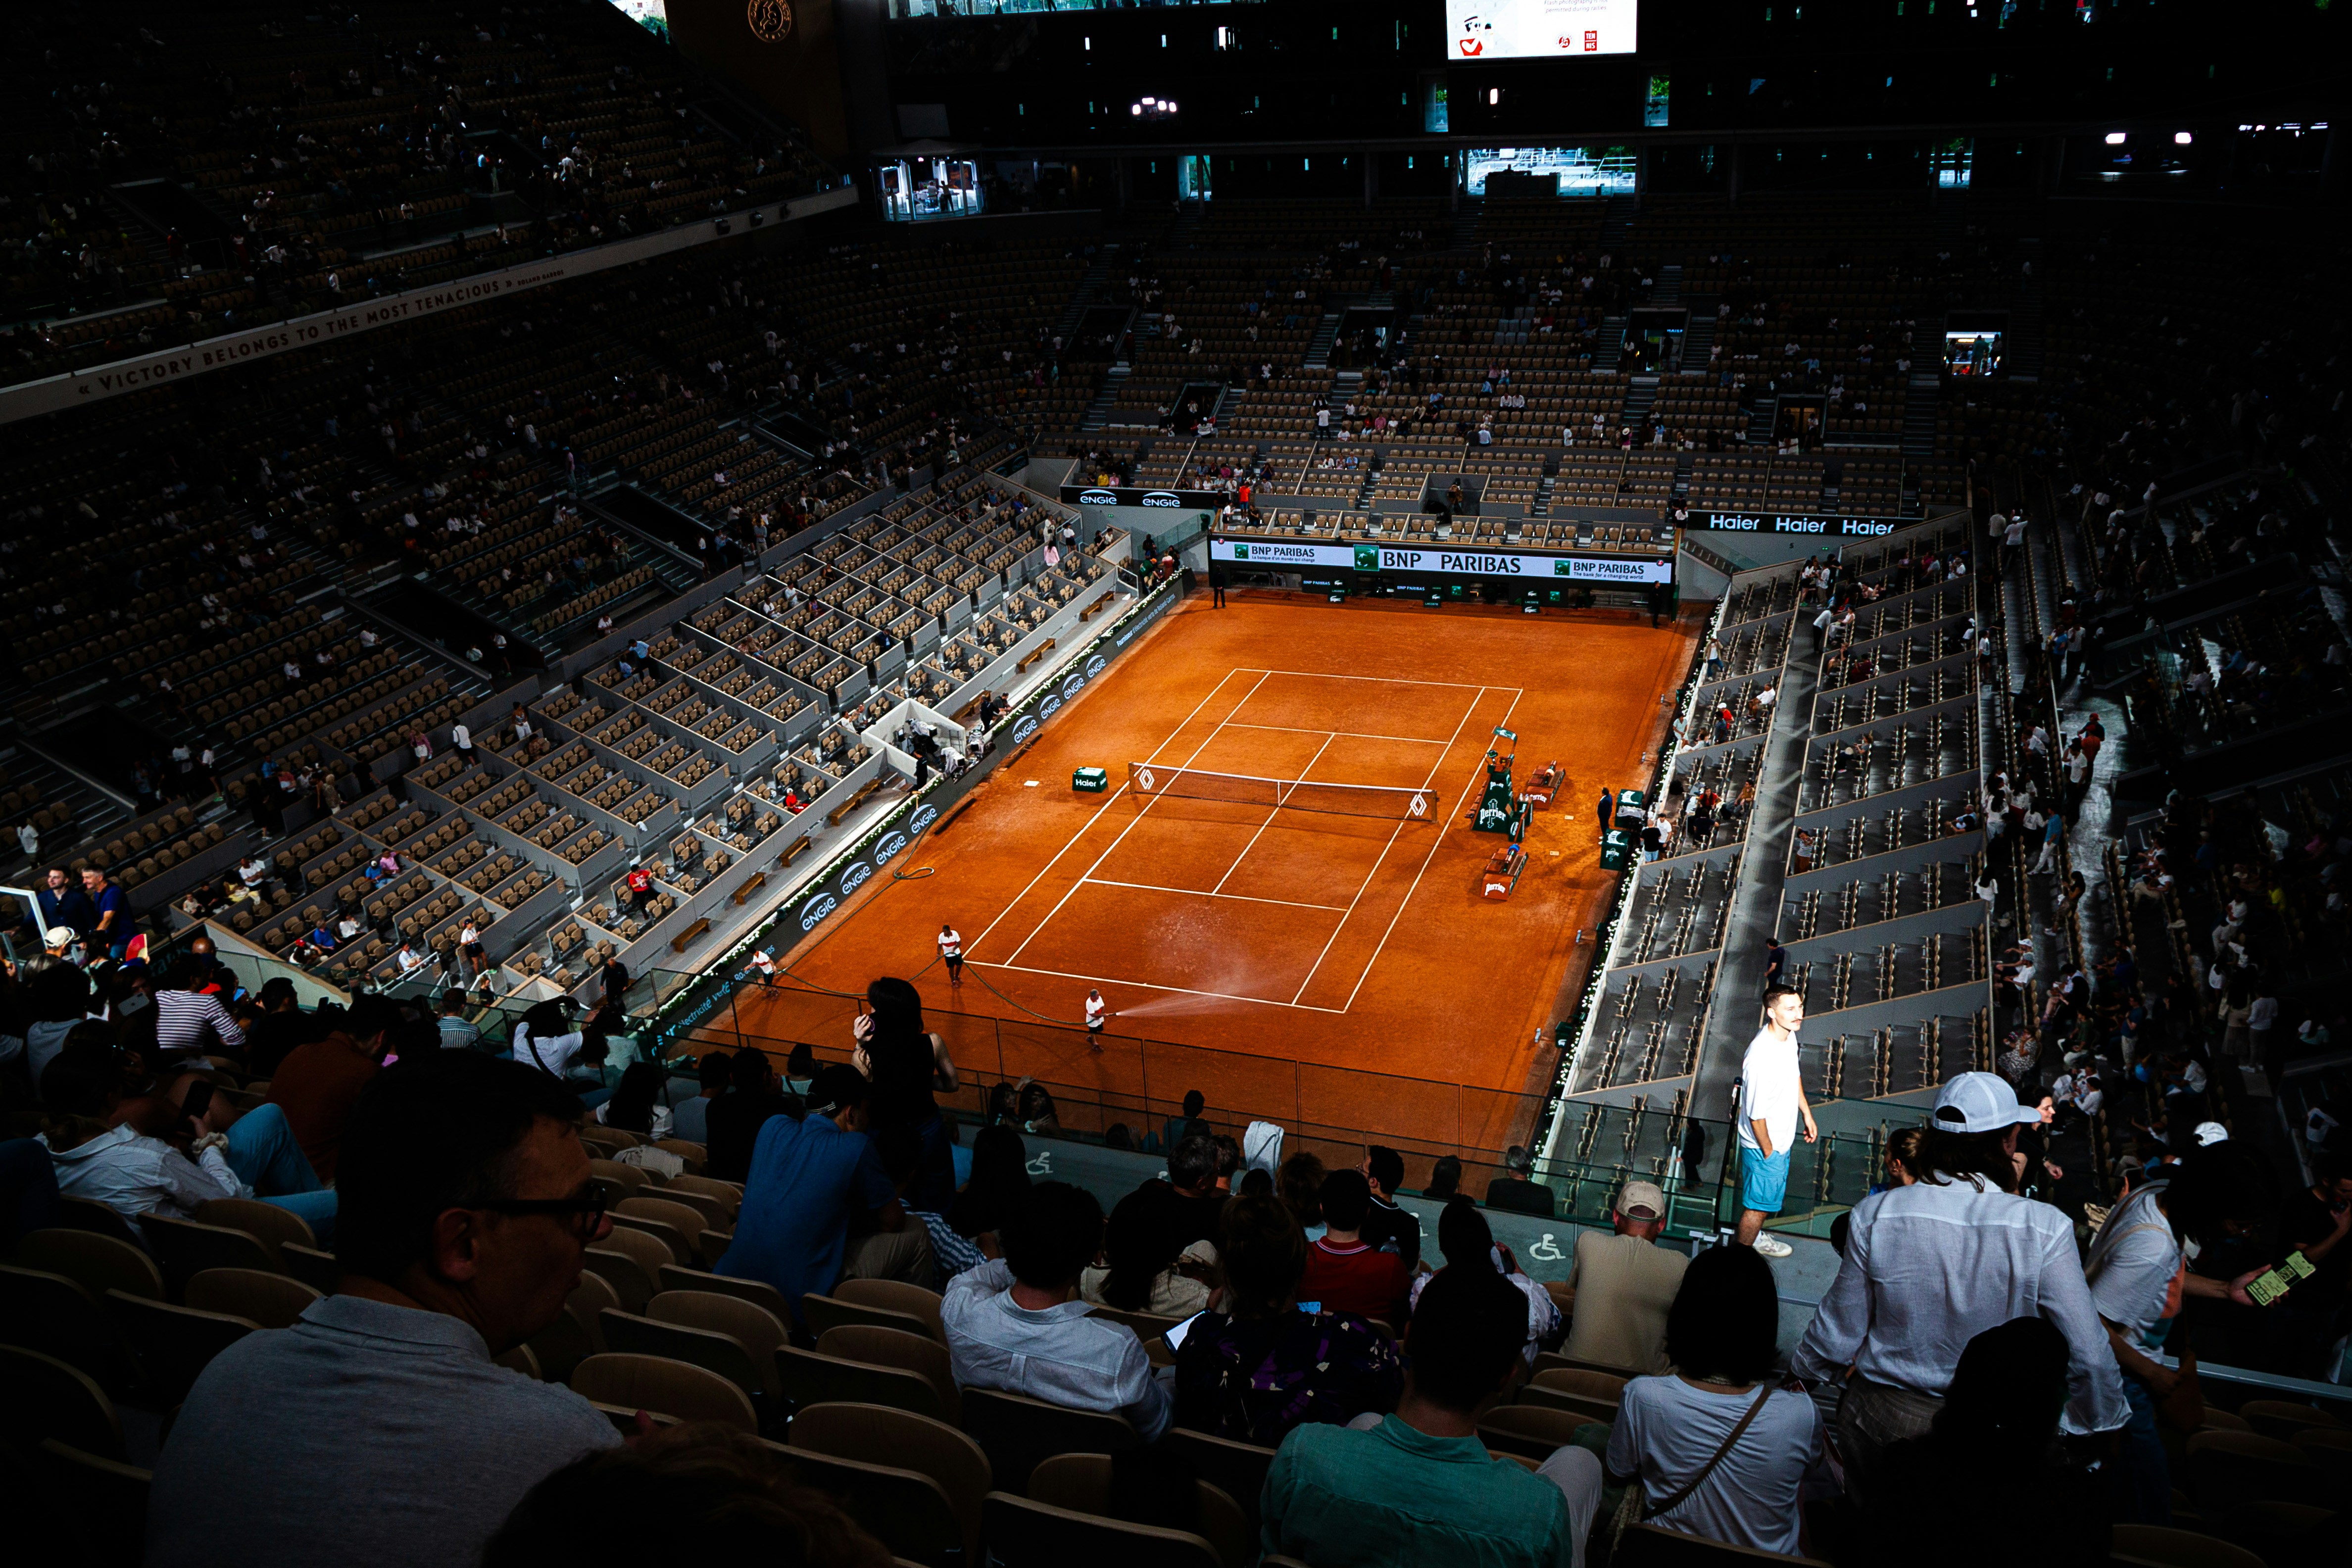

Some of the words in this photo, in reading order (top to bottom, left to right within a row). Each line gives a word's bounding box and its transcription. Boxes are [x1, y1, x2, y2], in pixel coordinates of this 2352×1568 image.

[99, 357, 191, 391] VICTORY
[202, 333, 289, 365] BELONGS
[297, 326, 319, 341] TO
[326, 316, 359, 334] THE
[367, 303, 408, 324] MOST
[415, 281, 499, 311] TENACIOUS
[518, 276, 541, 286] ROLAND
[542, 269, 564, 279] GARROS
[1710, 514, 1760, 530] Haier
[1775, 517, 1827, 533] Haier
[1842, 520, 1895, 535] Haier
[1252, 546, 1272, 555] BNP
[1274, 547, 1315, 557] PARIBAS
[1383, 551, 1421, 568] BNP
[1441, 554, 1521, 573] PARIBAS
[1573, 562, 1596, 572] BNP
[1598, 563, 1644, 574] PARIBAS
[1076, 779, 1096, 787] Haier
